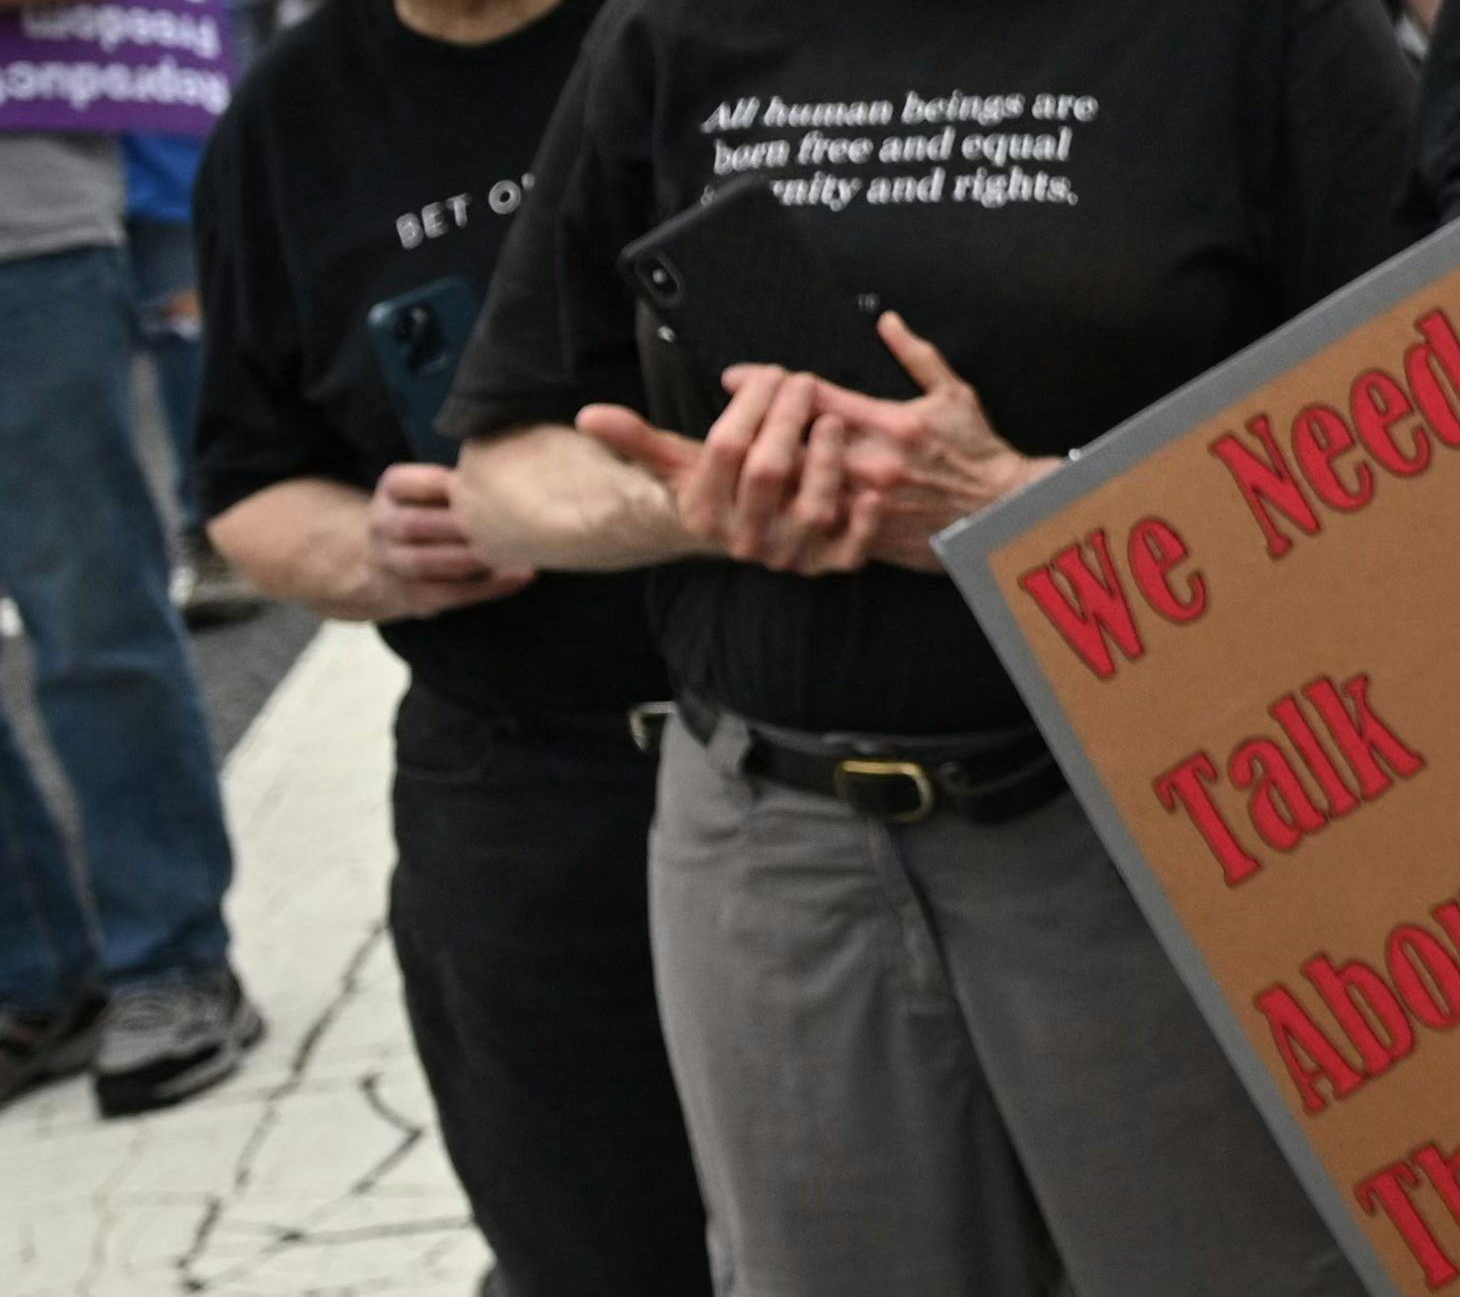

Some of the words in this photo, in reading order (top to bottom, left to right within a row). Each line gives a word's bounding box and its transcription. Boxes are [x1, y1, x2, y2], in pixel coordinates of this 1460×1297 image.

[701, 95, 761, 133] All
[764, 95, 895, 128] human
[901, 89, 1025, 126] beings
[1031, 93, 1099, 122] are
[713, 138, 790, 176] born
[798, 130, 874, 165] free
[879, 126, 956, 162] and
[961, 125, 1073, 167] equal
[866, 166, 946, 204] and
[396, 191, 473, 251] BET
[1017, 515, 1208, 683] We
[1154, 671, 1428, 889] Talk
